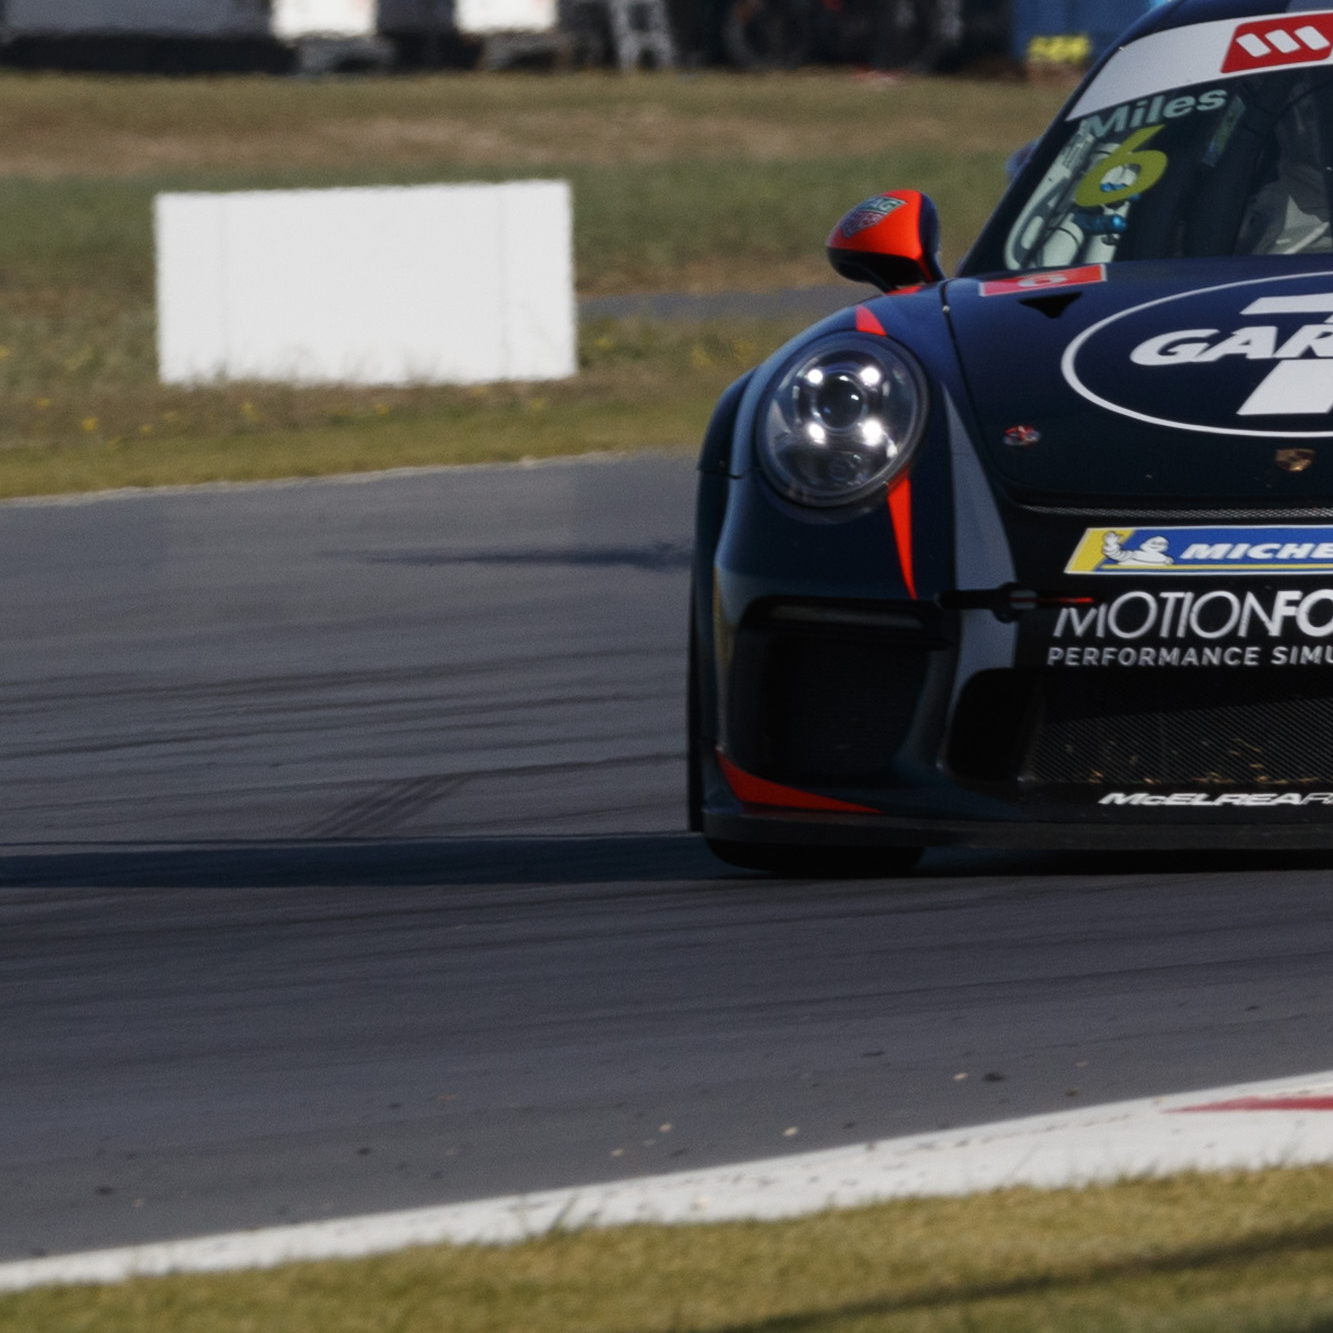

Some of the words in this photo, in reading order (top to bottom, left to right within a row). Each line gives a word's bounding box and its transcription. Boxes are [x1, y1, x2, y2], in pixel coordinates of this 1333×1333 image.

[1083, 89, 1228, 138] Miles
[1075, 124, 1168, 207] 6
[1047, 645, 1260, 666] PERFORMANCE
